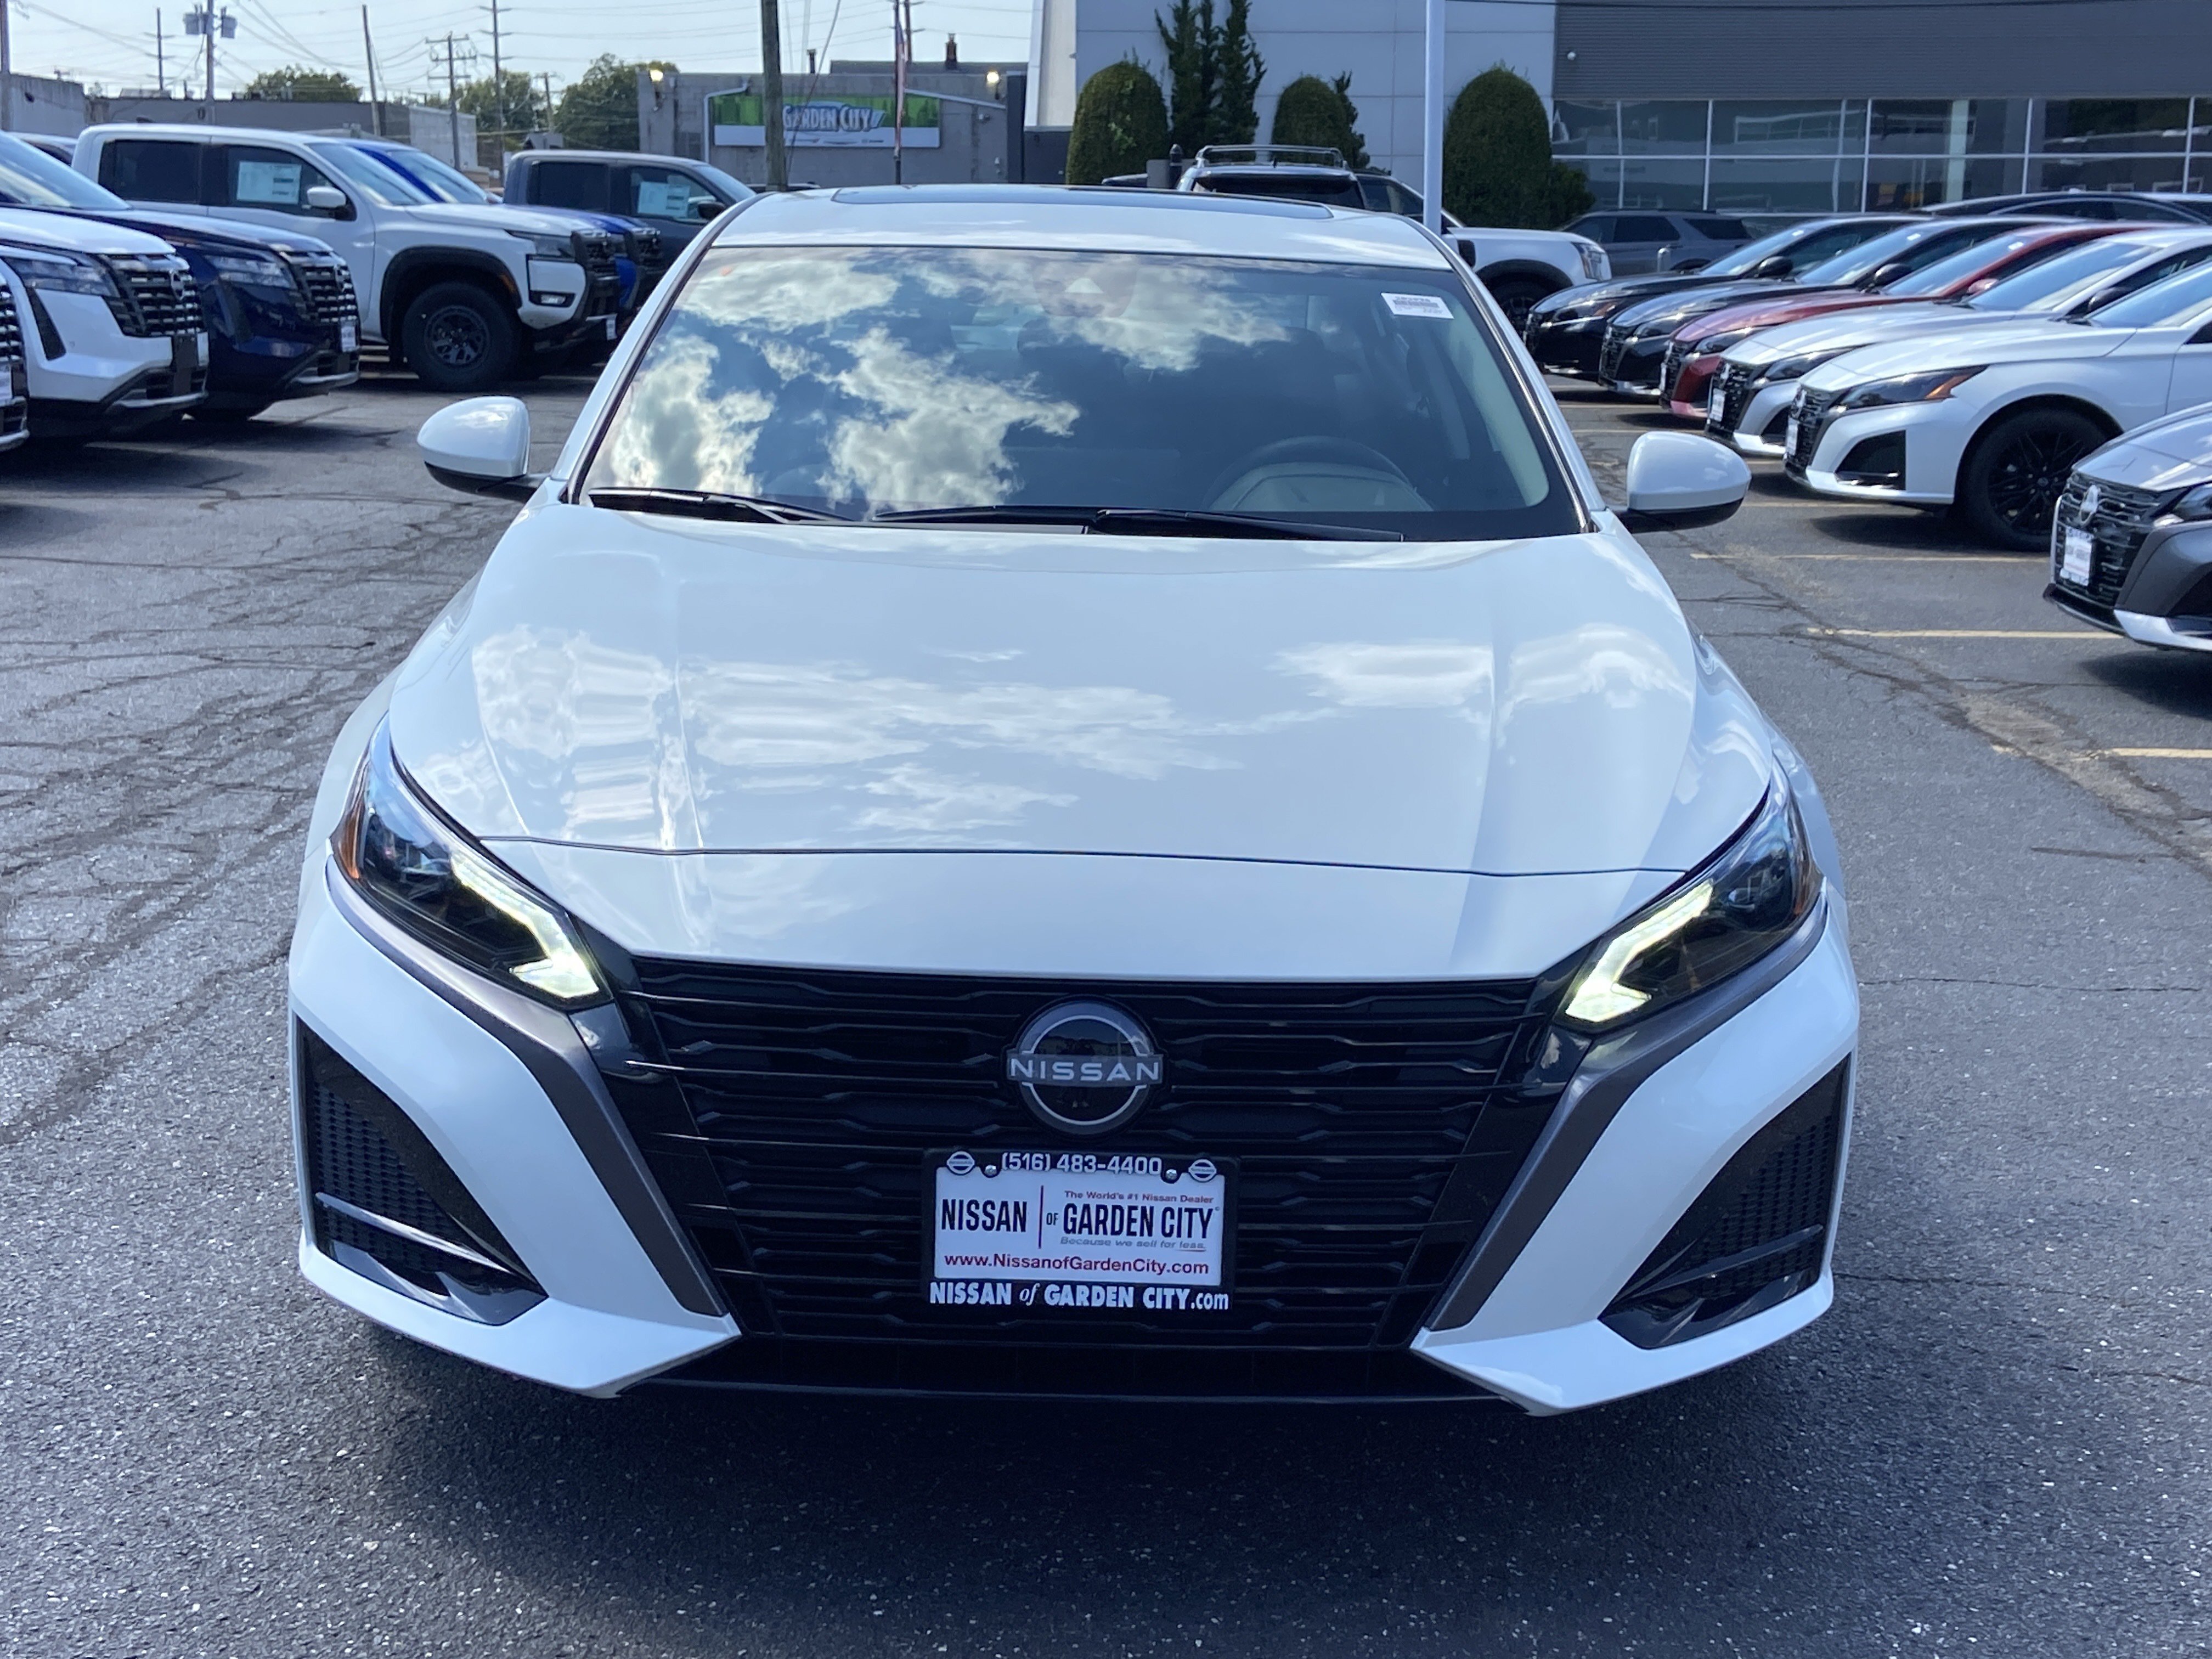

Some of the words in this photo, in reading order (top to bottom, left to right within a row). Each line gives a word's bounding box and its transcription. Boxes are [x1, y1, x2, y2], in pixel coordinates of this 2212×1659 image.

[1010, 1058, 1159, 1081] NISSAN
[1002, 1152, 1051, 1172] (516)
[1056, 1153, 1163, 1175] 483-4400
[1064, 1190, 1084, 1199] The
[1086, 1191, 1124, 1200] World's
[1142, 1193, 1177, 1203] Nissan
[1180, 1195, 1214, 1204] Dealer
[941, 1198, 1028, 1232] NISSAN
[1046, 1212, 1059, 1226] OF
[1063, 1203, 1154, 1238] GARDEN
[1160, 1206, 1214, 1239] CITY
[1059, 1236, 1111, 1246] Because
[1136, 1239, 1157, 1248] sell
[1160, 1240, 1176, 1249] for
[1179, 1240, 1206, 1249] less.
[944, 1253, 1209, 1276] www.NissanofGardenCity.com
[930, 1282, 1012, 1305] NISSAN
[1019, 1282, 1041, 1307] of
[1043, 1284, 1135, 1308] GARDEN
[1142, 1286, 1229, 1311] CITY.com
